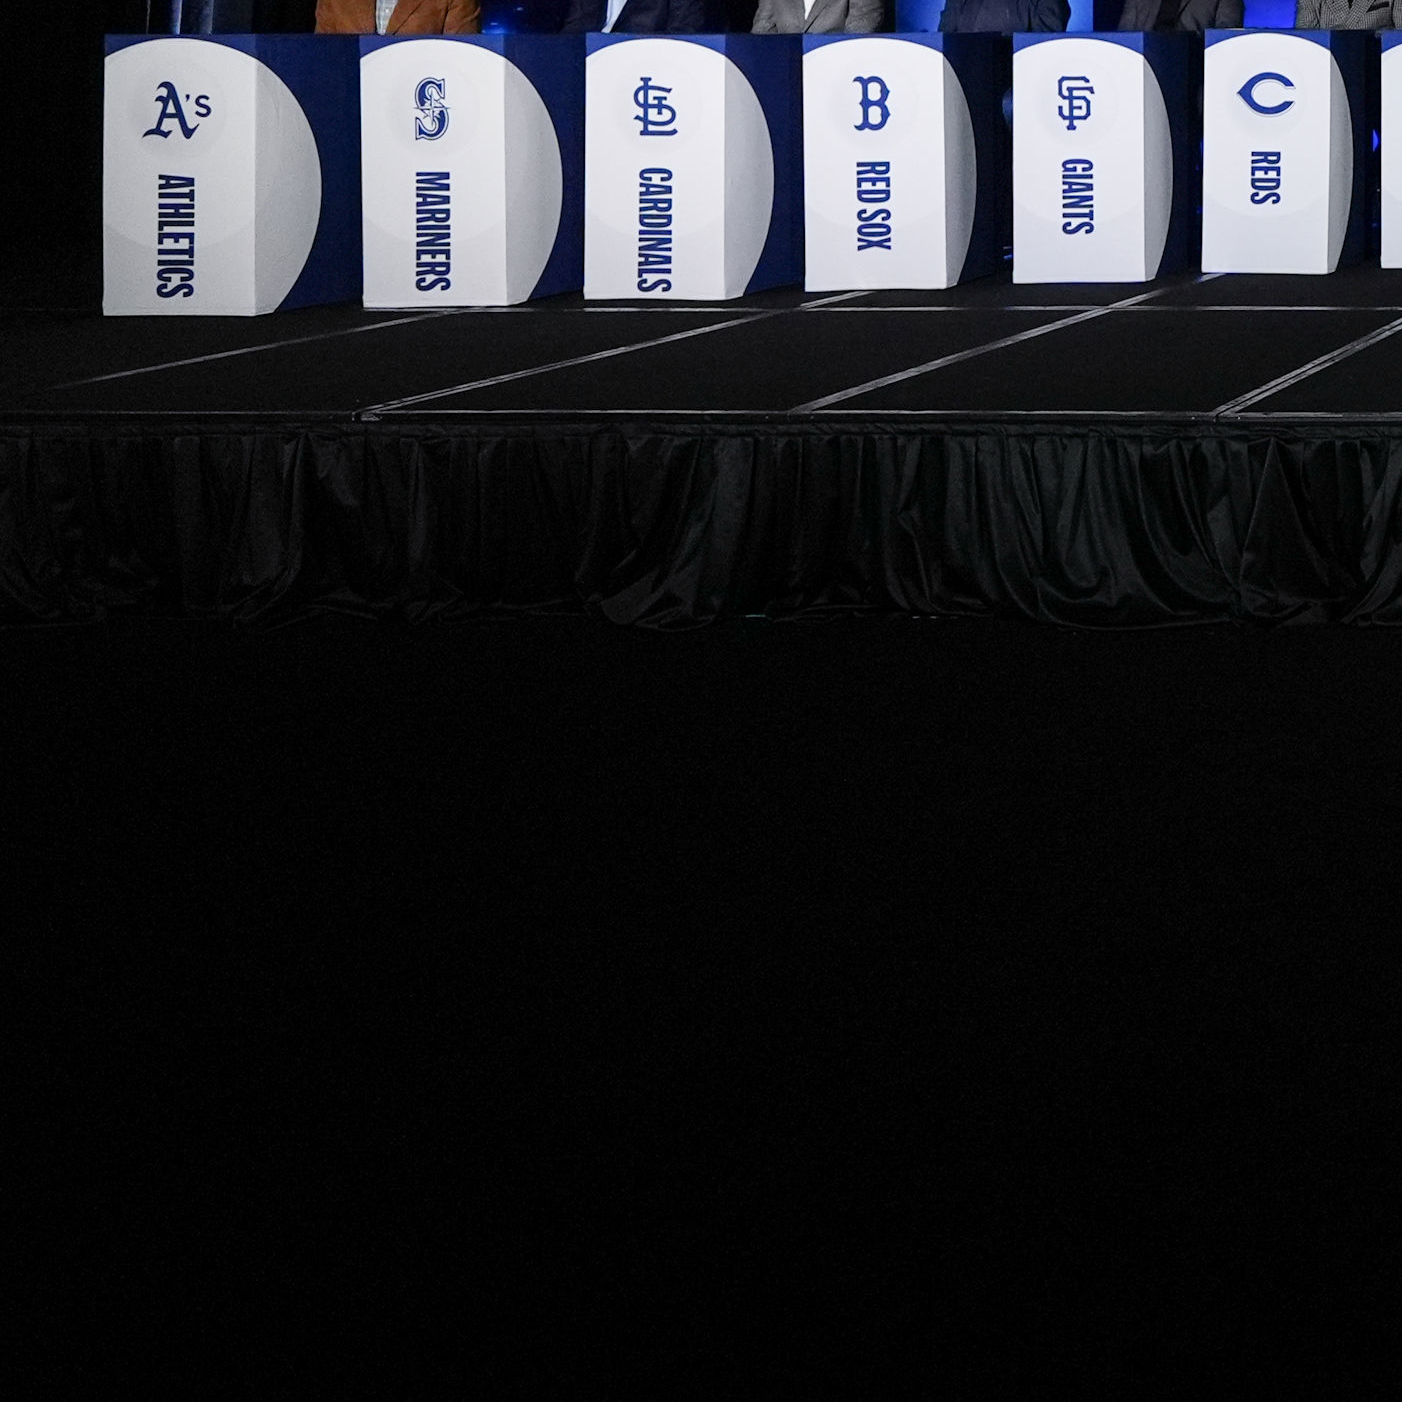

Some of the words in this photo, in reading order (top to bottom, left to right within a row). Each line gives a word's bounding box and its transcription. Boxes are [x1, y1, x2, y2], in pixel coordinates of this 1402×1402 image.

[852, 76, 891, 132] B
[1237, 71, 1297, 117] C
[856, 161, 891, 203] RED
[1061, 158, 1094, 235] GIANTS
[1250, 151, 1282, 205] REDS
[156, 173, 196, 299] ATHLETICS
[415, 171, 452, 292] MARINERS
[637, 167, 673, 293] CARDINALS
[856, 208, 892, 251] SOX
